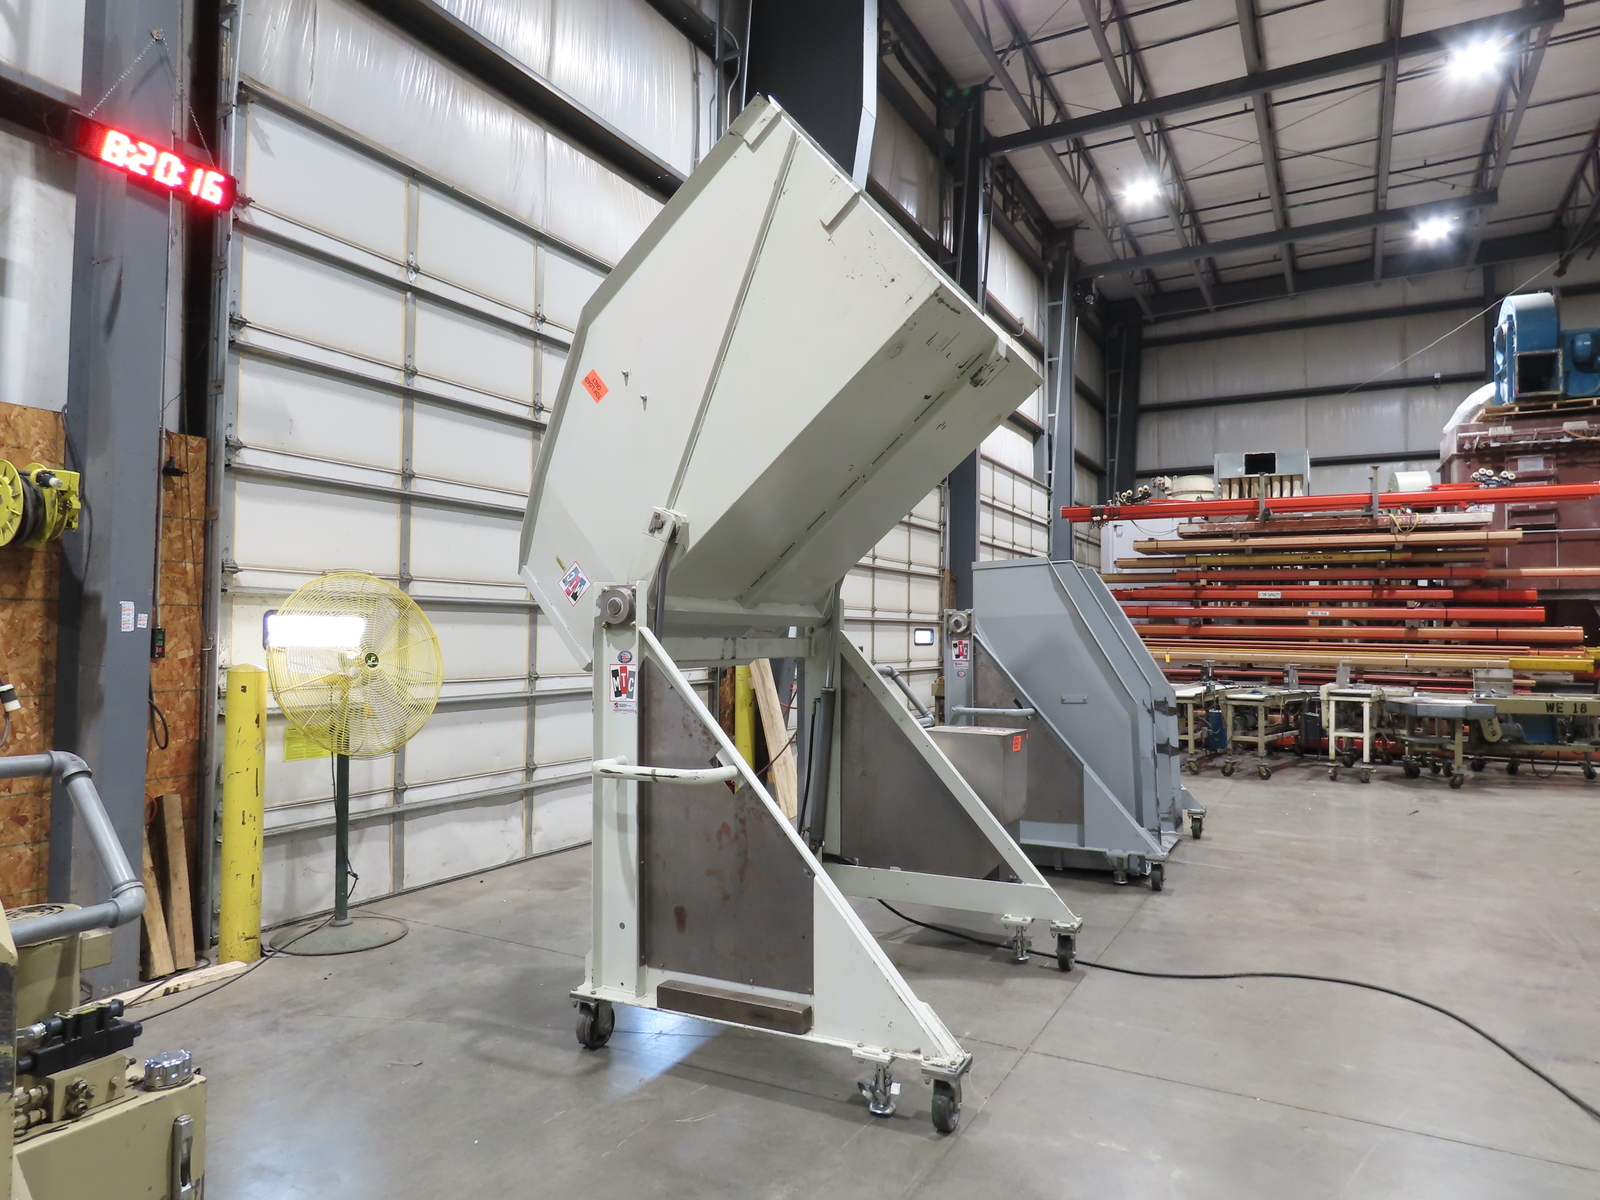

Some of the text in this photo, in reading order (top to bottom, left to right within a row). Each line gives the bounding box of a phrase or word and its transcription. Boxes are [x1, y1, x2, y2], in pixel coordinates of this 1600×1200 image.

[101, 130, 225, 205] 8:20:16
[584, 376, 601, 400] TOP LOAD
[591, 377, 602, 391] ONLY
[612, 669, 635, 695] MTC
[1545, 702, 1588, 714] WE 18
